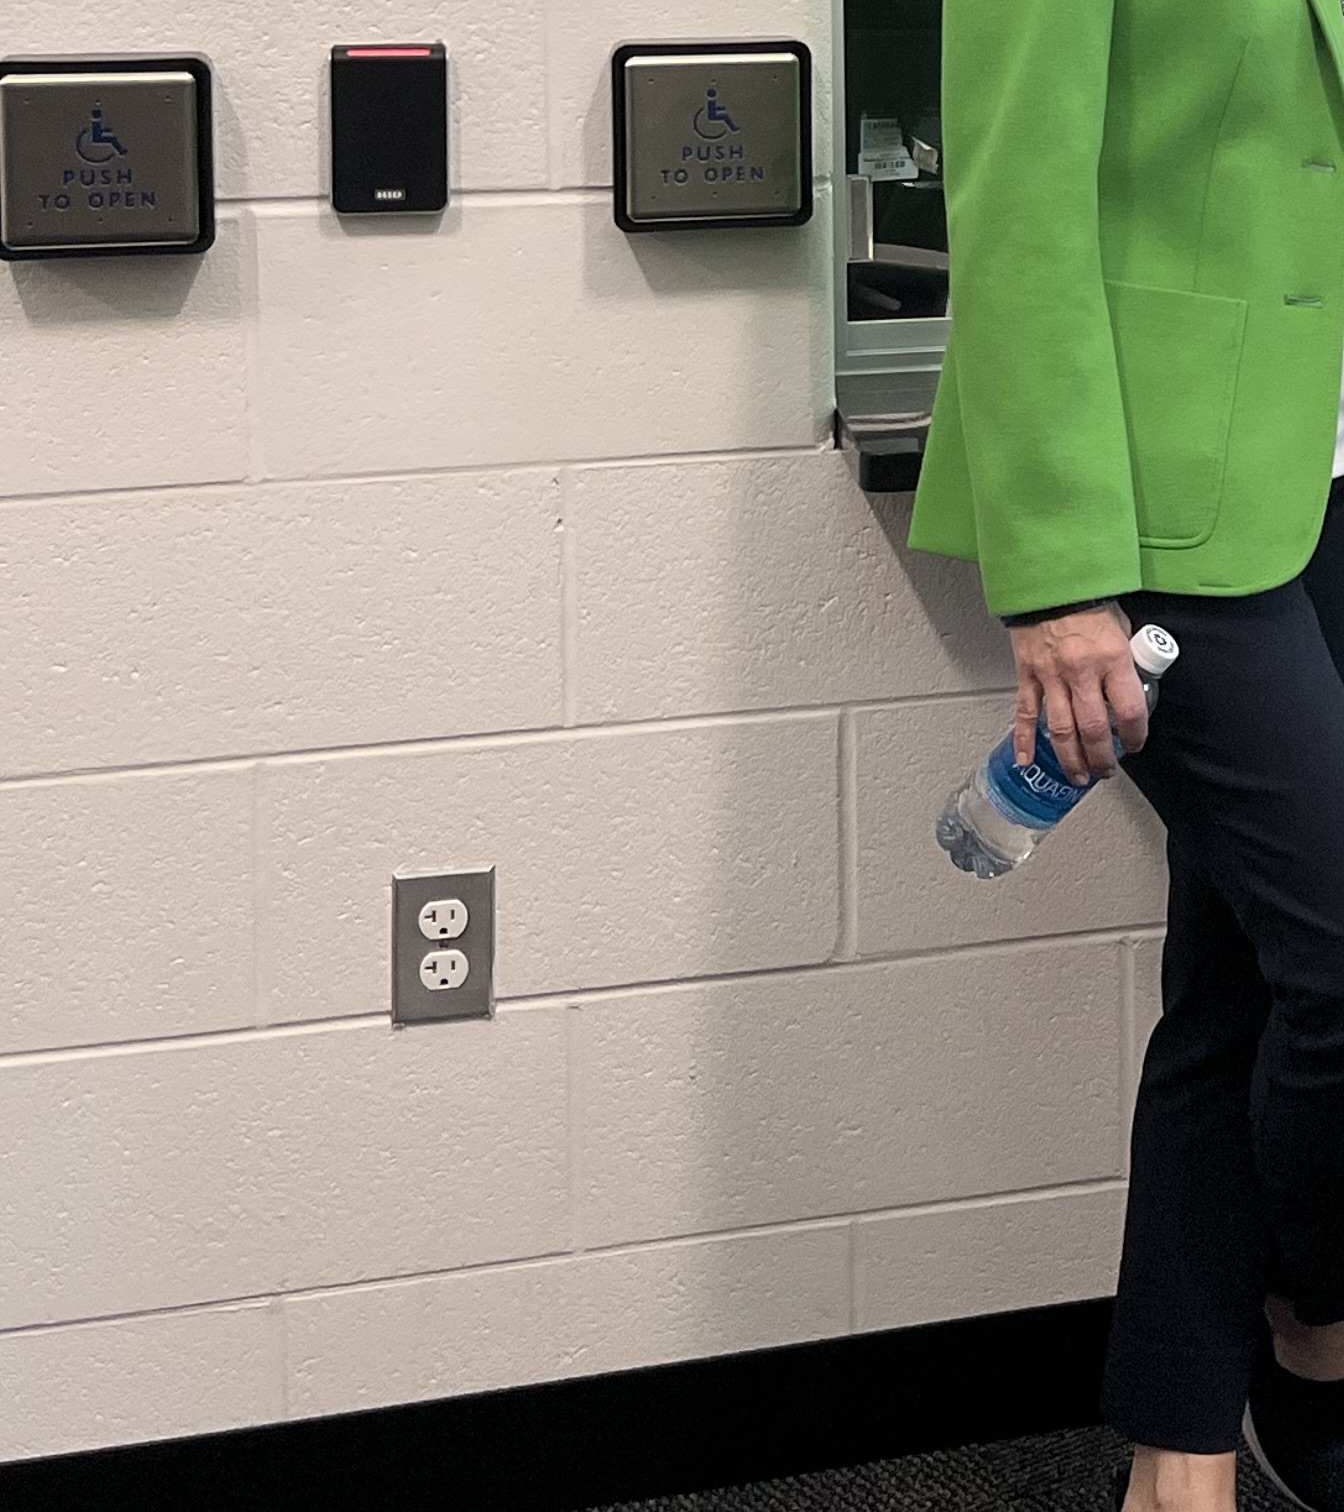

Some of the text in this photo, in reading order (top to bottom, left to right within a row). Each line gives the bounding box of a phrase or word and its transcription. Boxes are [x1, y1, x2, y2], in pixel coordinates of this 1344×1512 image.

[681, 146, 744, 162] PUSH
[62, 168, 132, 187] PUSH
[660, 167, 764, 185] TO OPEN
[39, 191, 156, 210] TO OPEN
